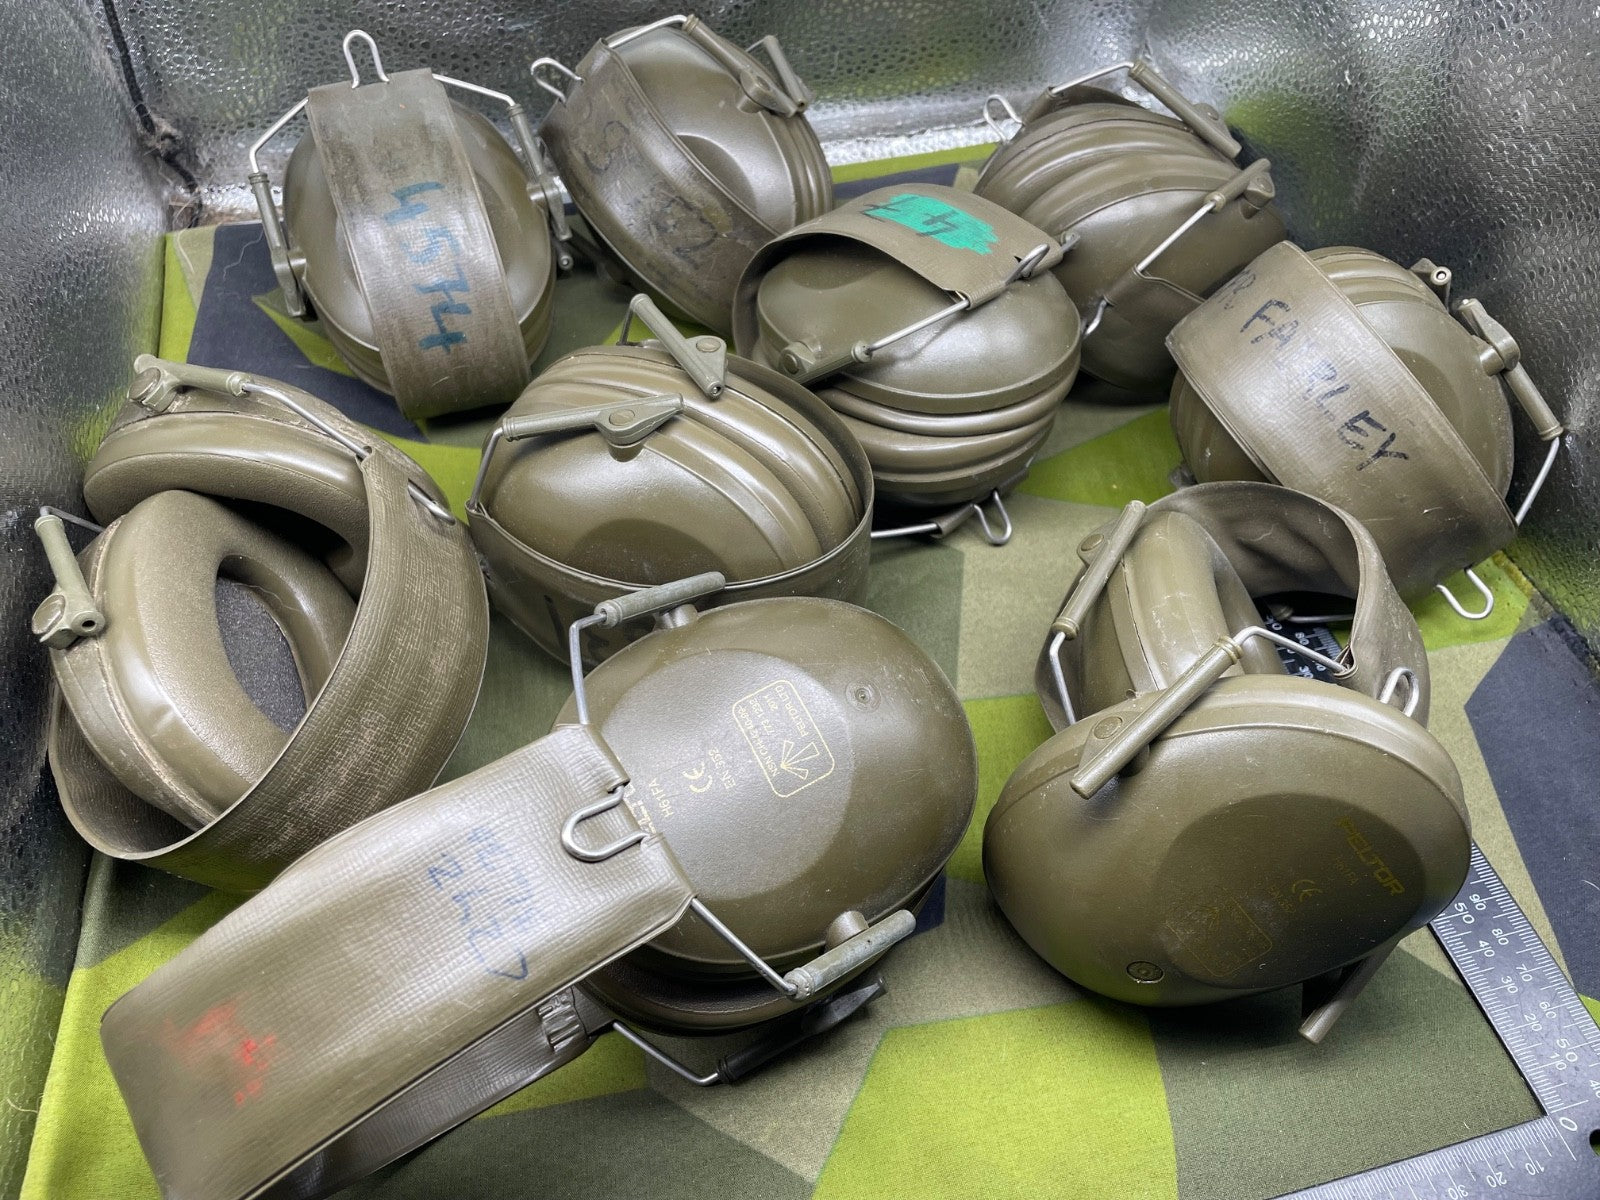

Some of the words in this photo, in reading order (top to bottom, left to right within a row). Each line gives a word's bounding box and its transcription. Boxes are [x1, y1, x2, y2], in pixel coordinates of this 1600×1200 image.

[383, 181, 472, 356] 4574
[774, 685, 788, 703] LTD
[784, 701, 809, 738] PELTOR
[708, 747, 724, 769] 352
[763, 754, 780, 777] NSN
[721, 767, 737, 790] EN
[648, 777, 675, 818] H61FA
[1469, 893, 1487, 911] 90
[1454, 902, 1475, 924] 50
[1491, 928, 1509, 946] 80
[1478, 940, 1495, 958] 40
[1516, 964, 1533, 982] 70
[1501, 976, 1519, 994] 30
[1539, 1001, 1557, 1019] 60
[1524, 1013, 1543, 1031] 20
[1556, 1038, 1578, 1062] 50
[1550, 1052, 1567, 1071] 10
[1558, 1116, 1578, 1132] 0
[1525, 1160, 1545, 1176] 10
[1486, 1171, 1508, 1188] 20
[1448, 1184, 1469, 1200] 30
